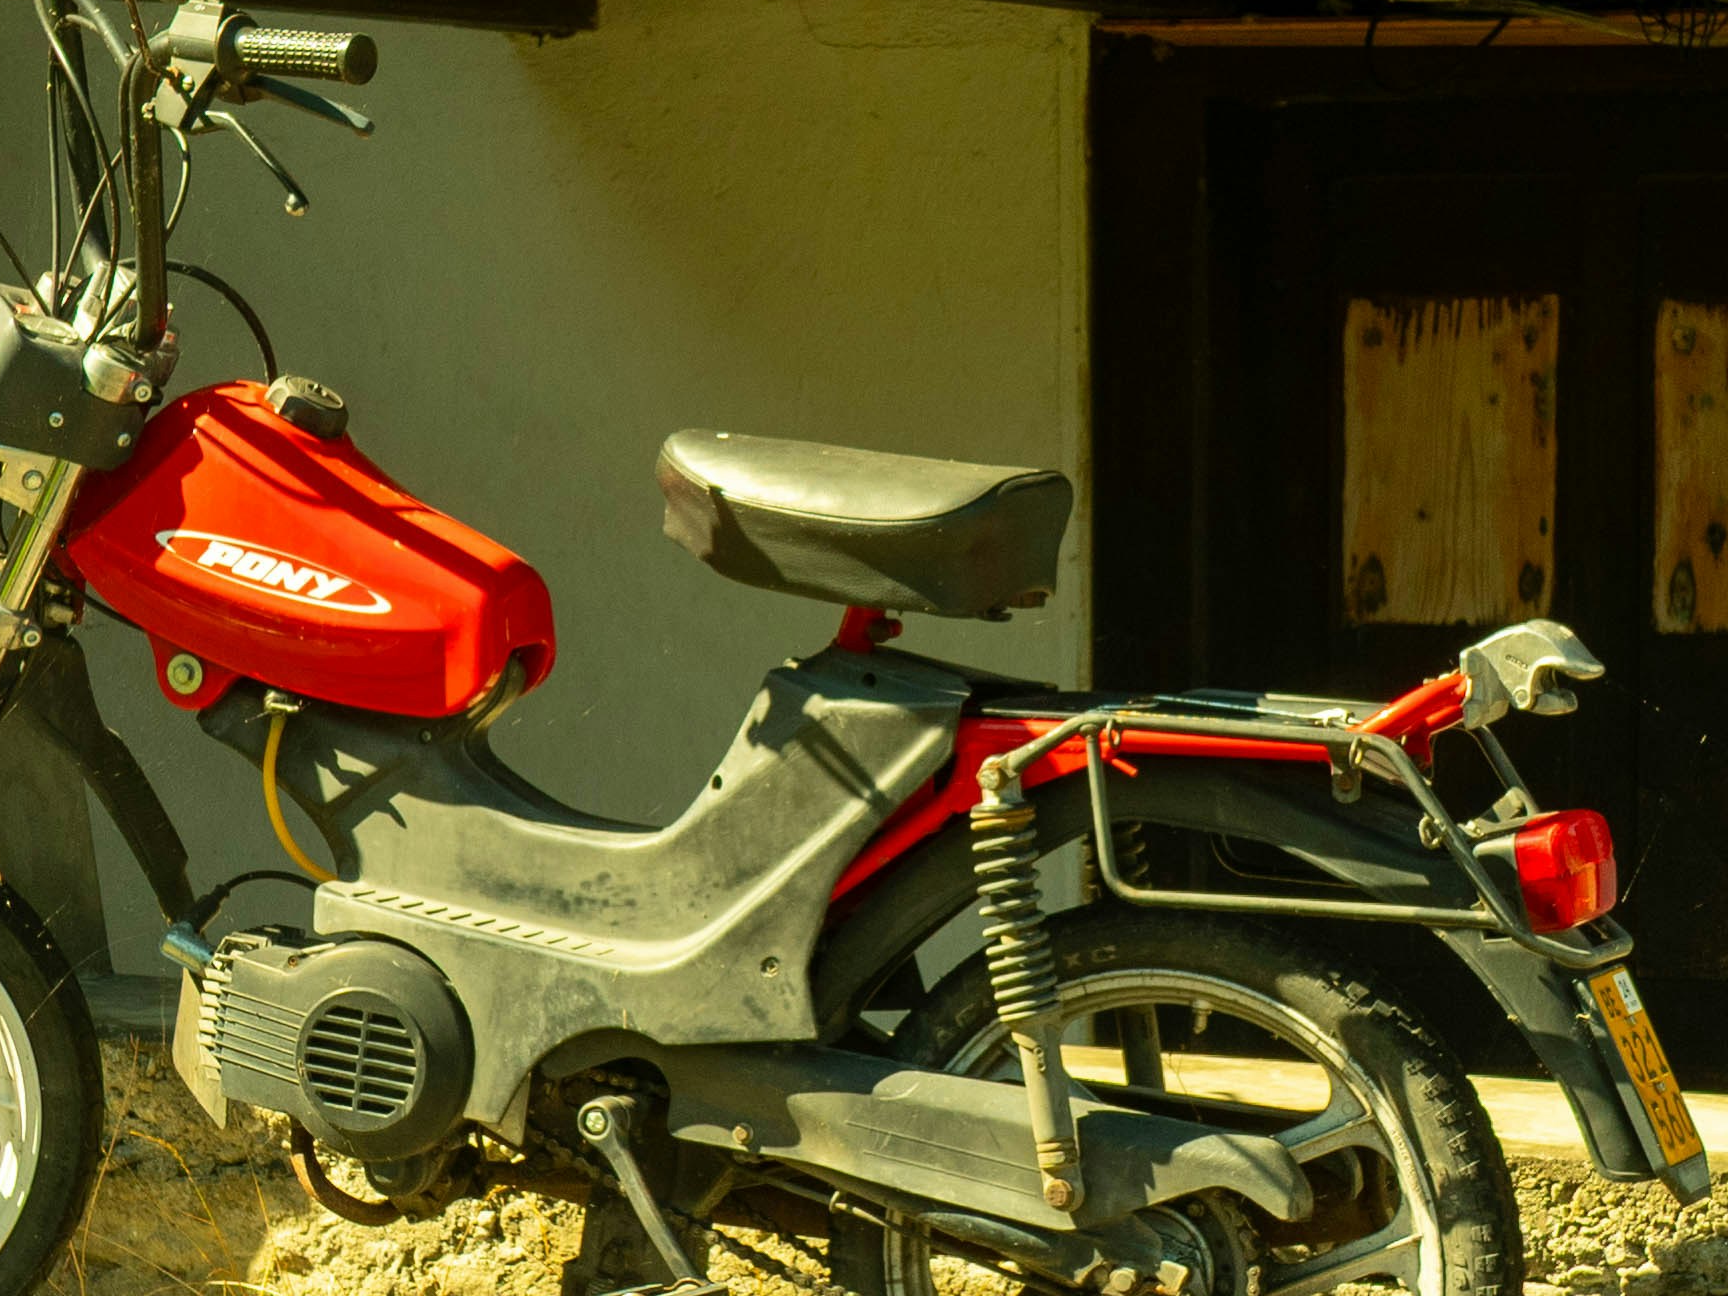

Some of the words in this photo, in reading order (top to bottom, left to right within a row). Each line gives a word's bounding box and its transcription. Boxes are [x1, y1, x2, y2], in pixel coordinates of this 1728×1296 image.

[197, 540, 352, 600] PONY
[1598, 986, 1622, 1018] BE
[1620, 1025, 1668, 1083] 321
[1650, 1091, 1696, 1150] 560
